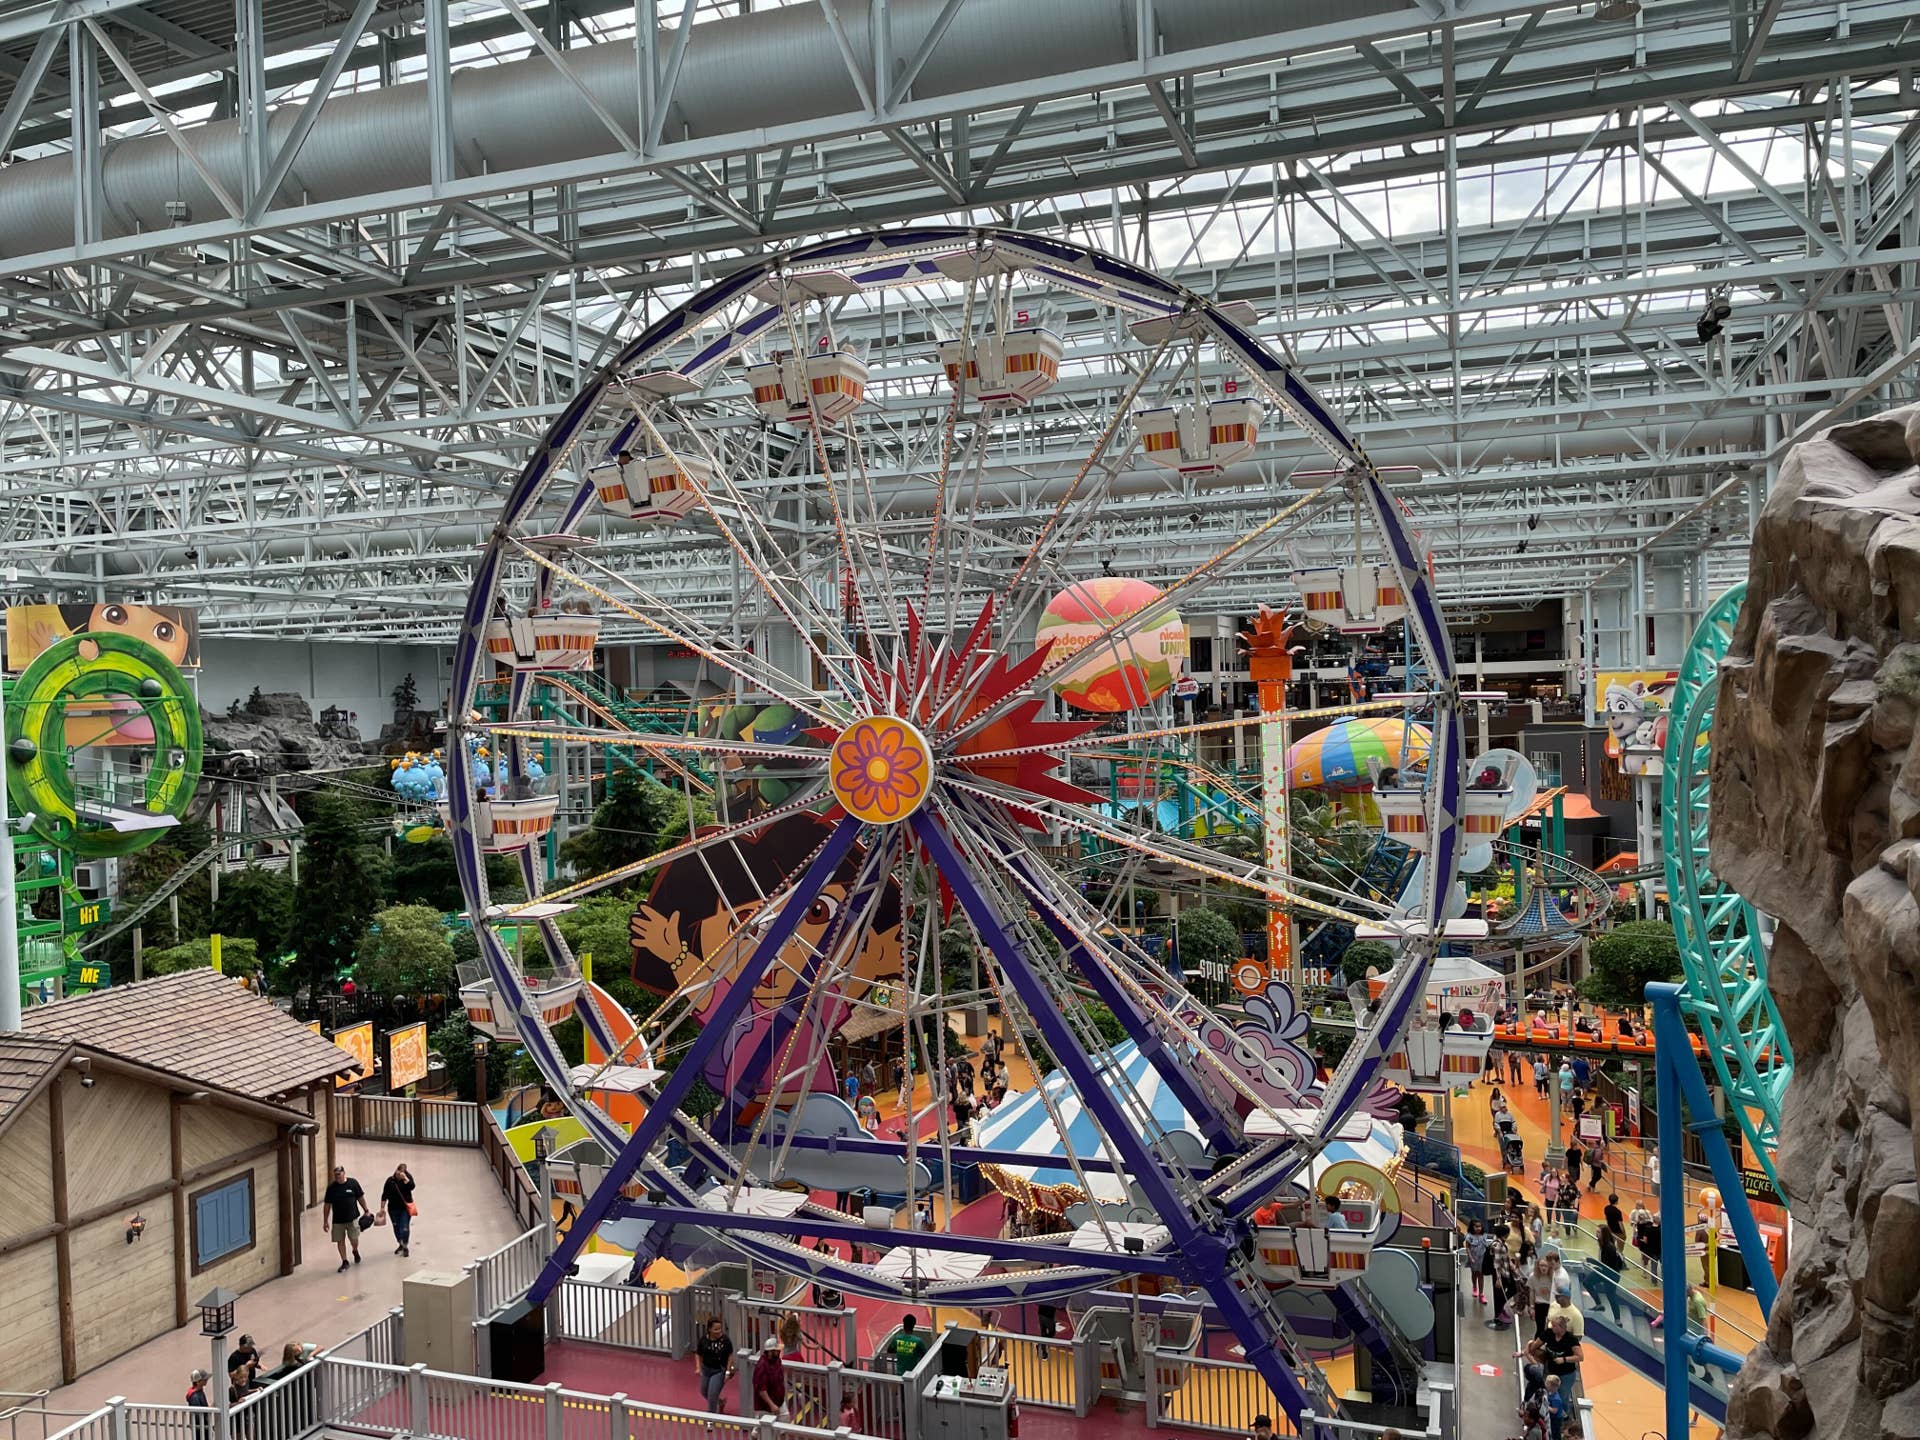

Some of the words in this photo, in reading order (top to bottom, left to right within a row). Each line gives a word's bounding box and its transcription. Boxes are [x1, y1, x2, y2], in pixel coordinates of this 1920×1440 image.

[1017, 310, 1029, 323] 5
[818, 336, 829, 347] 4
[1224, 381, 1238, 394] 6
[80, 967, 100, 983] ME
[1200, 959, 1230, 982] SPLAT
[1271, 967, 1327, 987] SPERE
[1745, 1178, 1776, 1192] TICKET
[896, 1340, 917, 1348] TEAM
